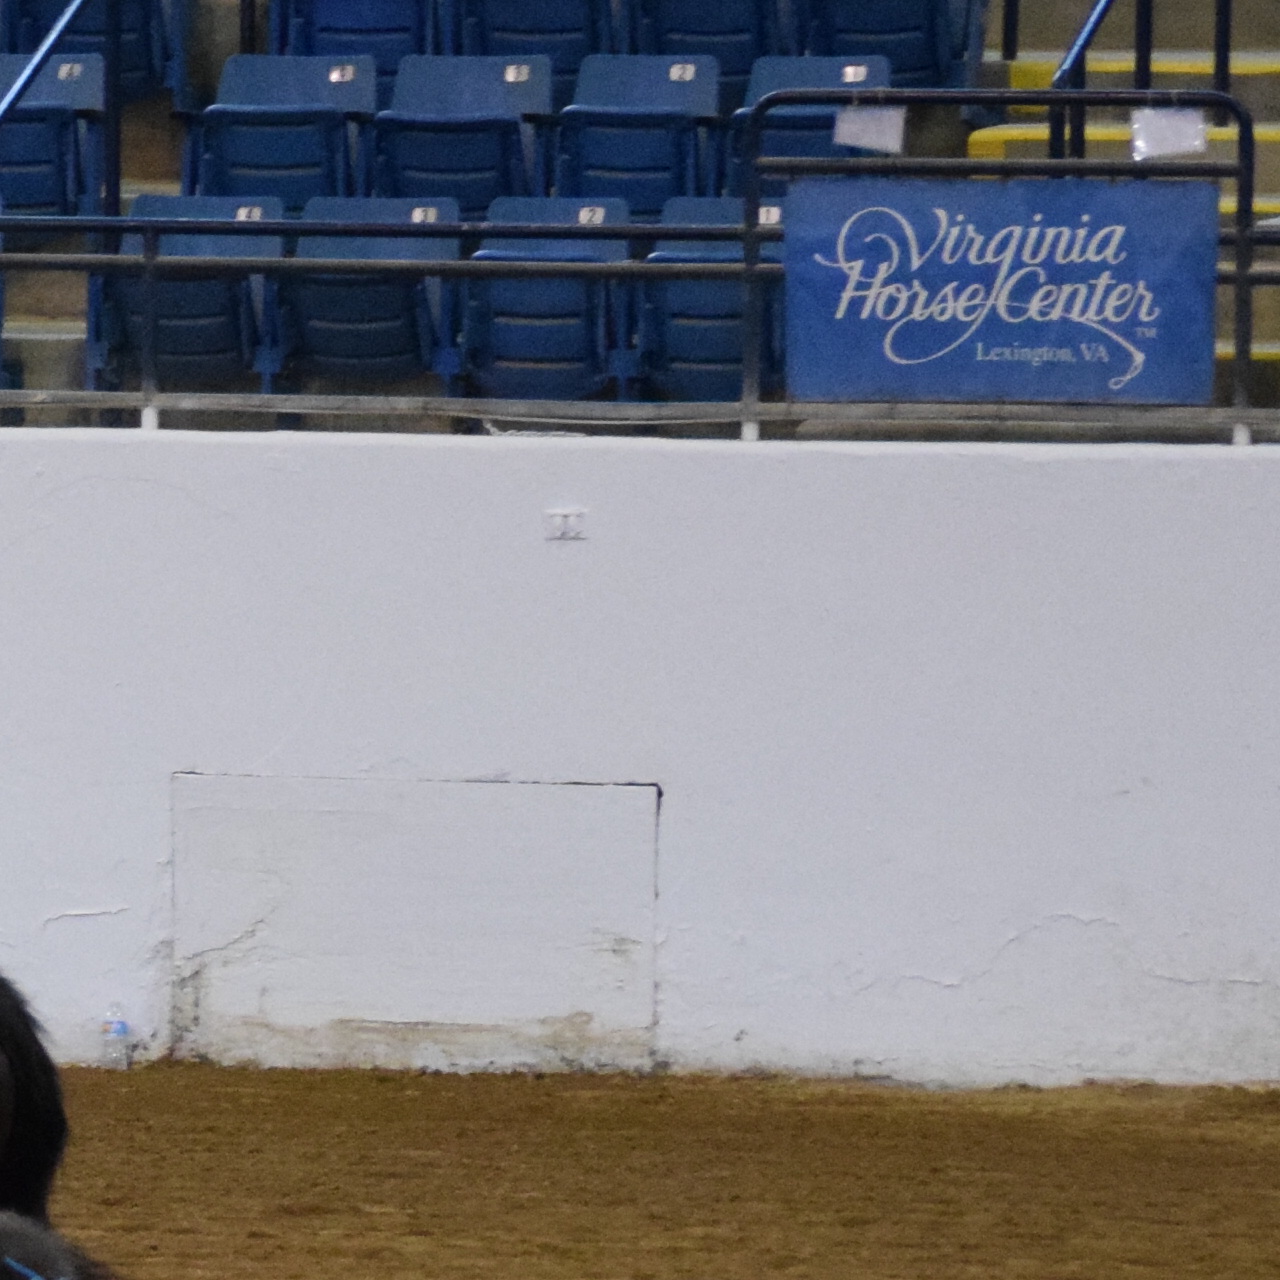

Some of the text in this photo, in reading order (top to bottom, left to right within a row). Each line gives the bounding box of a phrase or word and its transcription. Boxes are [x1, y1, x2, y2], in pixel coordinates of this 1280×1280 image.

[837, 206, 1127, 280] Virginia
[834, 259, 1162, 323] Horse Center
[976, 341, 1110, 366] Lexington, VA
